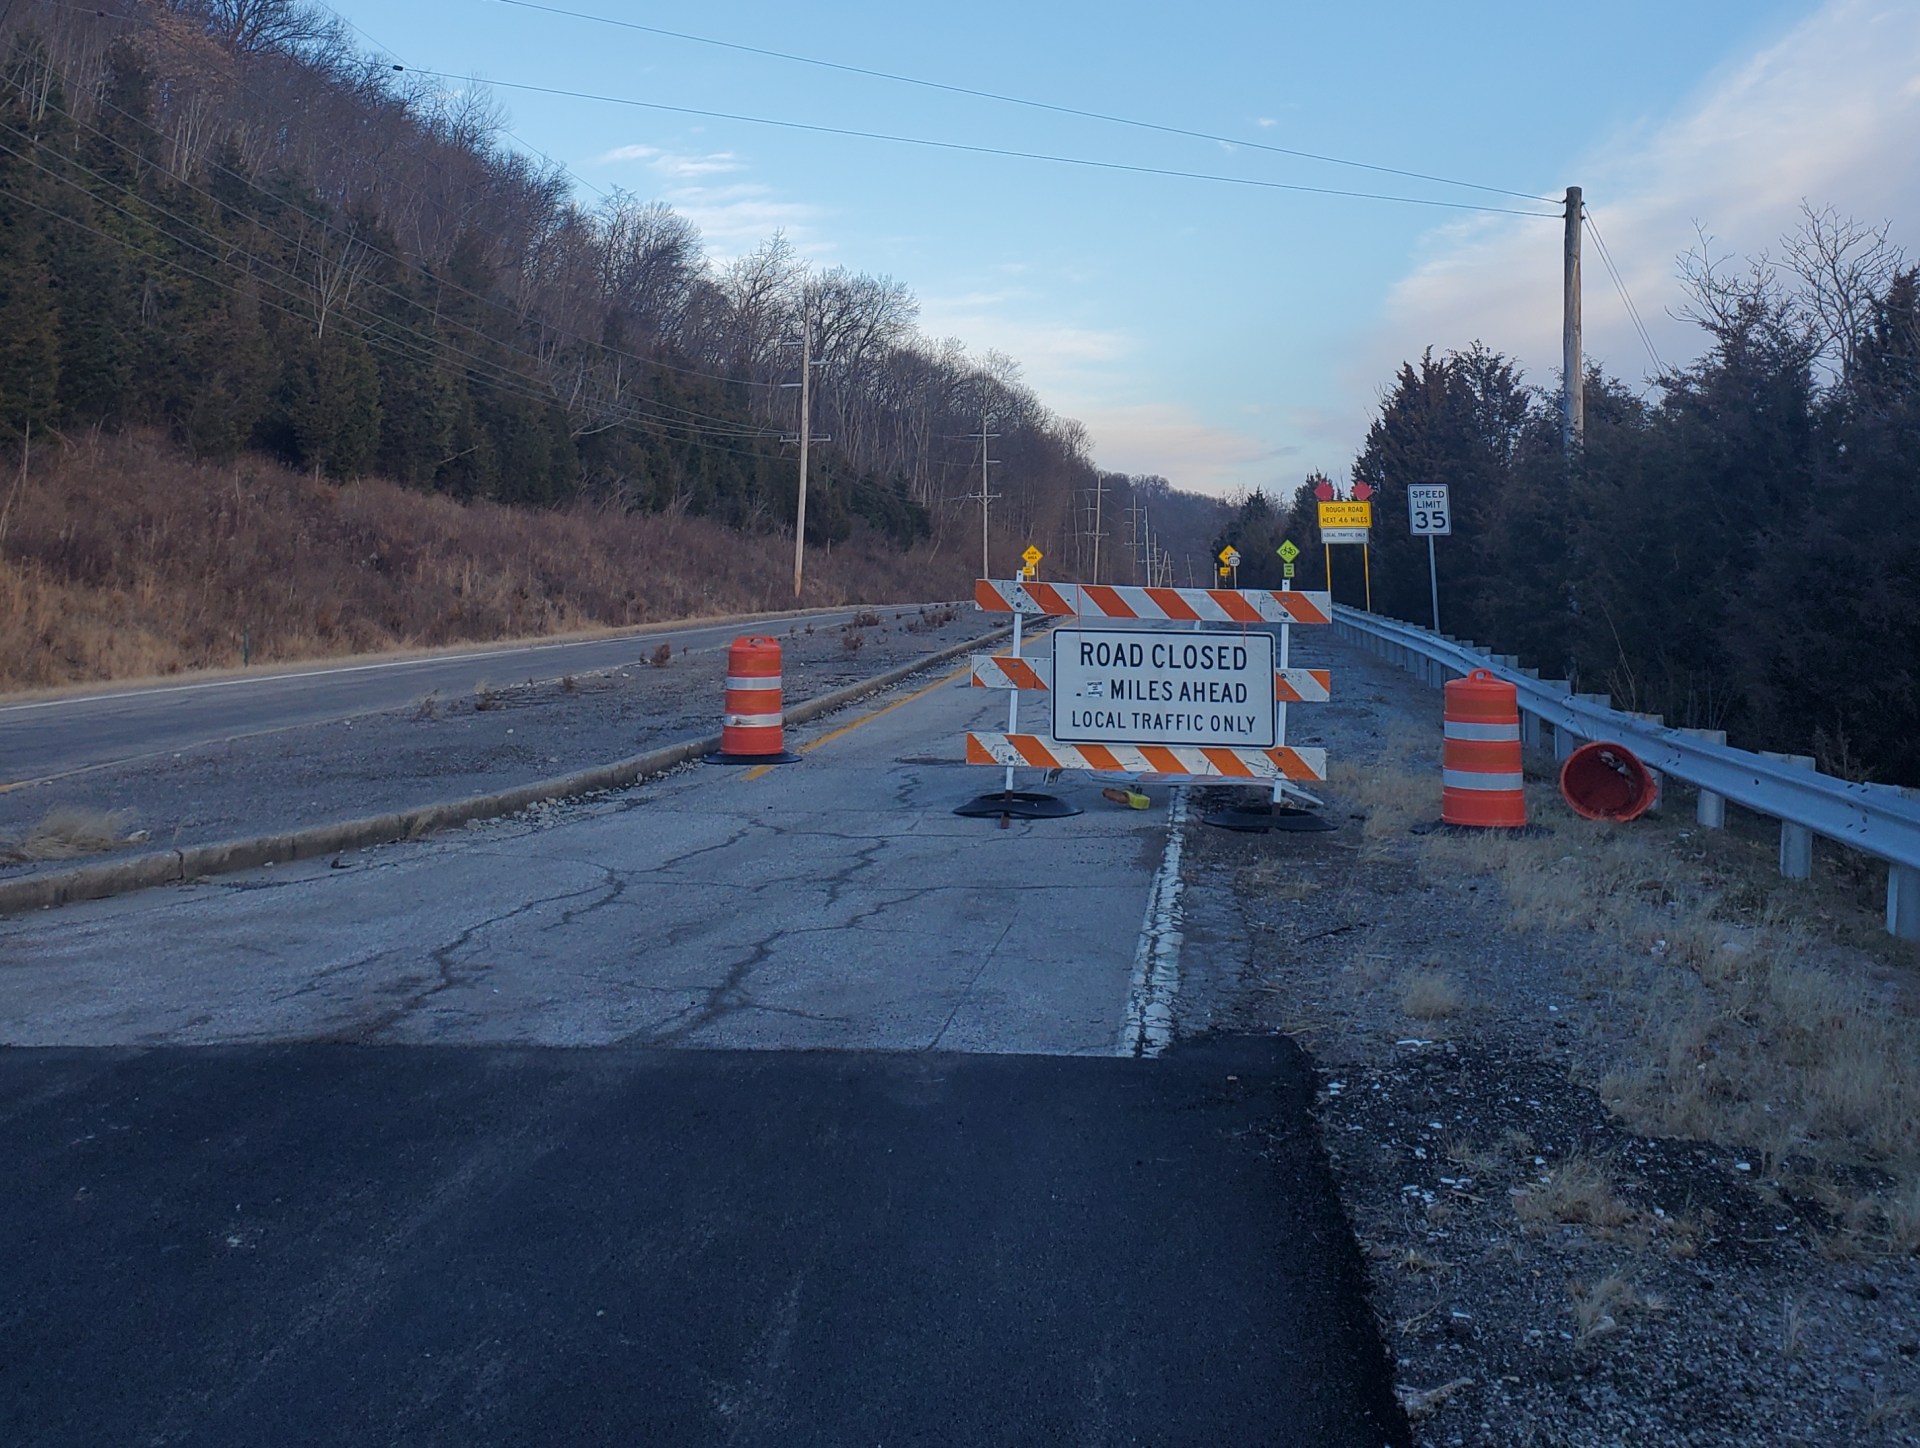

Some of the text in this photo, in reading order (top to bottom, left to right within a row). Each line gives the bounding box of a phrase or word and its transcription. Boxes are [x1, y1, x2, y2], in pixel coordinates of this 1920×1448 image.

[1412, 490, 1445, 498] SPEED
[1416, 501, 1441, 509] LIMIT
[1415, 511, 1446, 529] 35
[1080, 642, 1247, 671] ROAD CLOSED
[1111, 679, 1173, 701] MILES
[1179, 682, 1247, 703] AHEAD
[1072, 710, 1256, 733] LOCAL TRAFFIC ONLY
